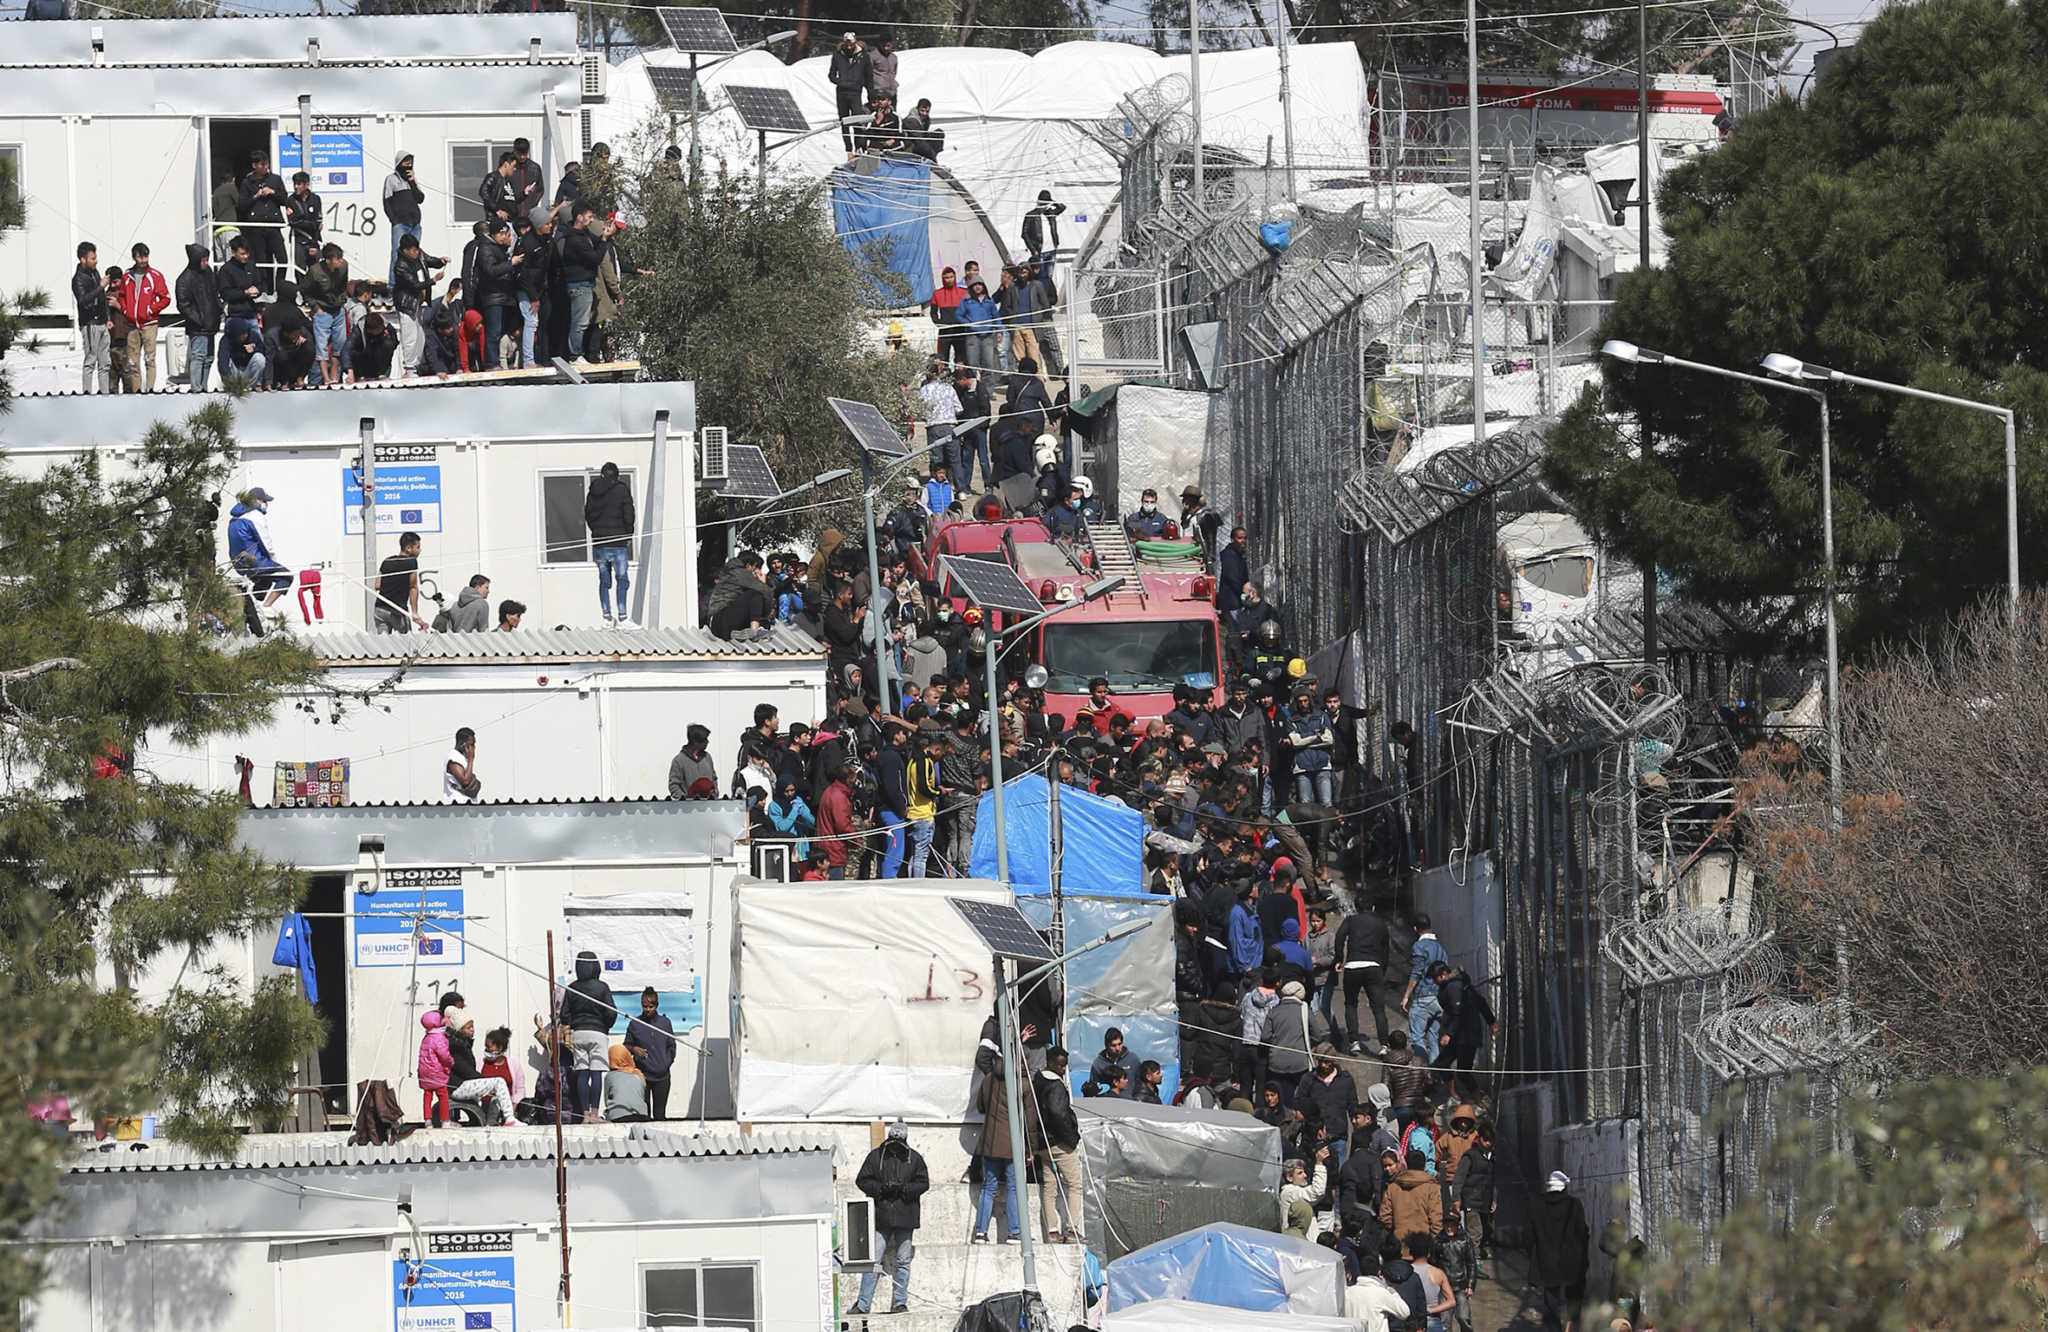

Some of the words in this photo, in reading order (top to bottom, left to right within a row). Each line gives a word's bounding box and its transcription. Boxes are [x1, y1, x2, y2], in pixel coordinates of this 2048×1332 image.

[1536, 98, 1573, 108] ΣΩΜΑ
[1670, 106, 1703, 114] SERVICE
[311, 118, 361, 126] SOBOX
[327, 201, 376, 236] 118
[375, 446, 435, 456] SOBOX
[386, 869, 461, 880] ISOBOX
[400, 920, 414, 928] 201
[430, 1233, 511, 1245] ISOBOX
[445, 1291, 465, 1299] 2016
[416, 1317, 456, 1327] UNHCR
